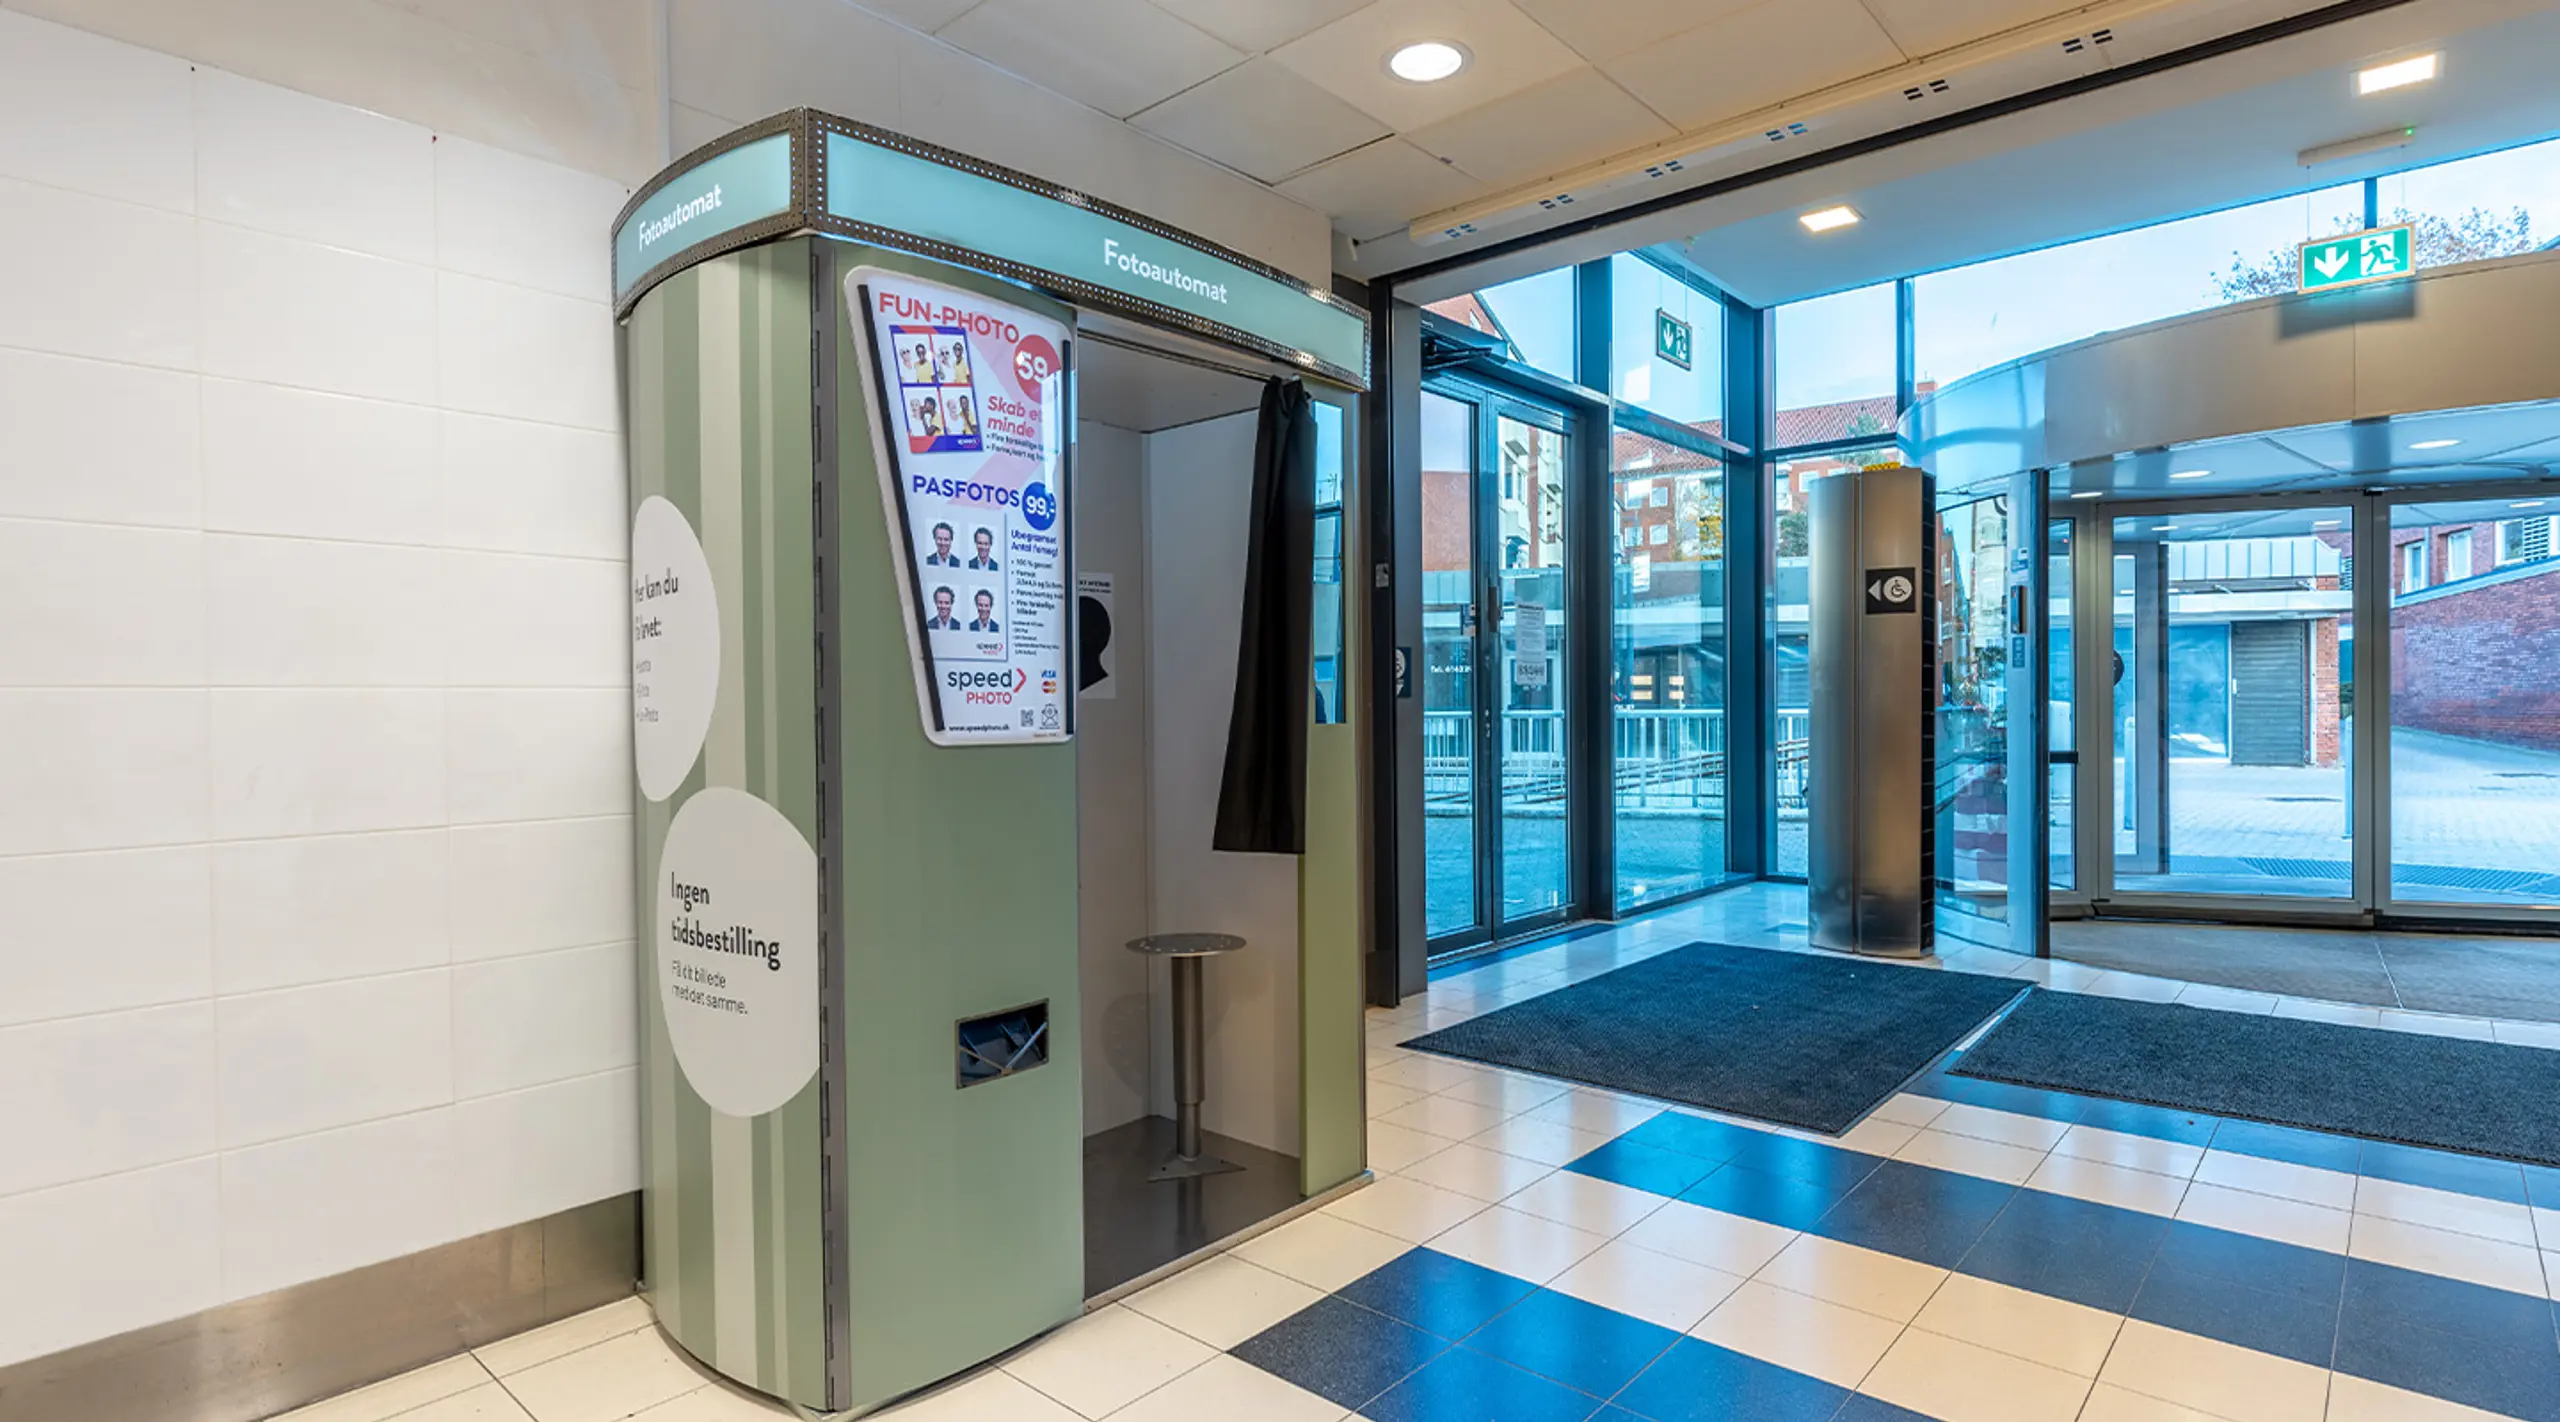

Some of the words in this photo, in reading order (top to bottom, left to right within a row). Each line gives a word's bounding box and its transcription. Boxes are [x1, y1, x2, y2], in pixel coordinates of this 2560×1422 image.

[639, 184, 722, 252] Fotoautomat
[1104, 238, 1228, 304] Fotoautomat
[879, 292, 1020, 345] FUN-PHOTO
[988, 396, 1026, 417] Skab
[987, 417, 1035, 438] minde
[912, 474, 1020, 508] PASFOTOS
[663, 566, 679, 595] du
[947, 669, 1013, 690] speed
[966, 691, 1013, 705] PHOTO
[671, 871, 710, 913] Ingen
[671, 916, 781, 971] tidsbestilling
[694, 966, 726, 988] billede
[706, 994, 748, 1015] samme.
